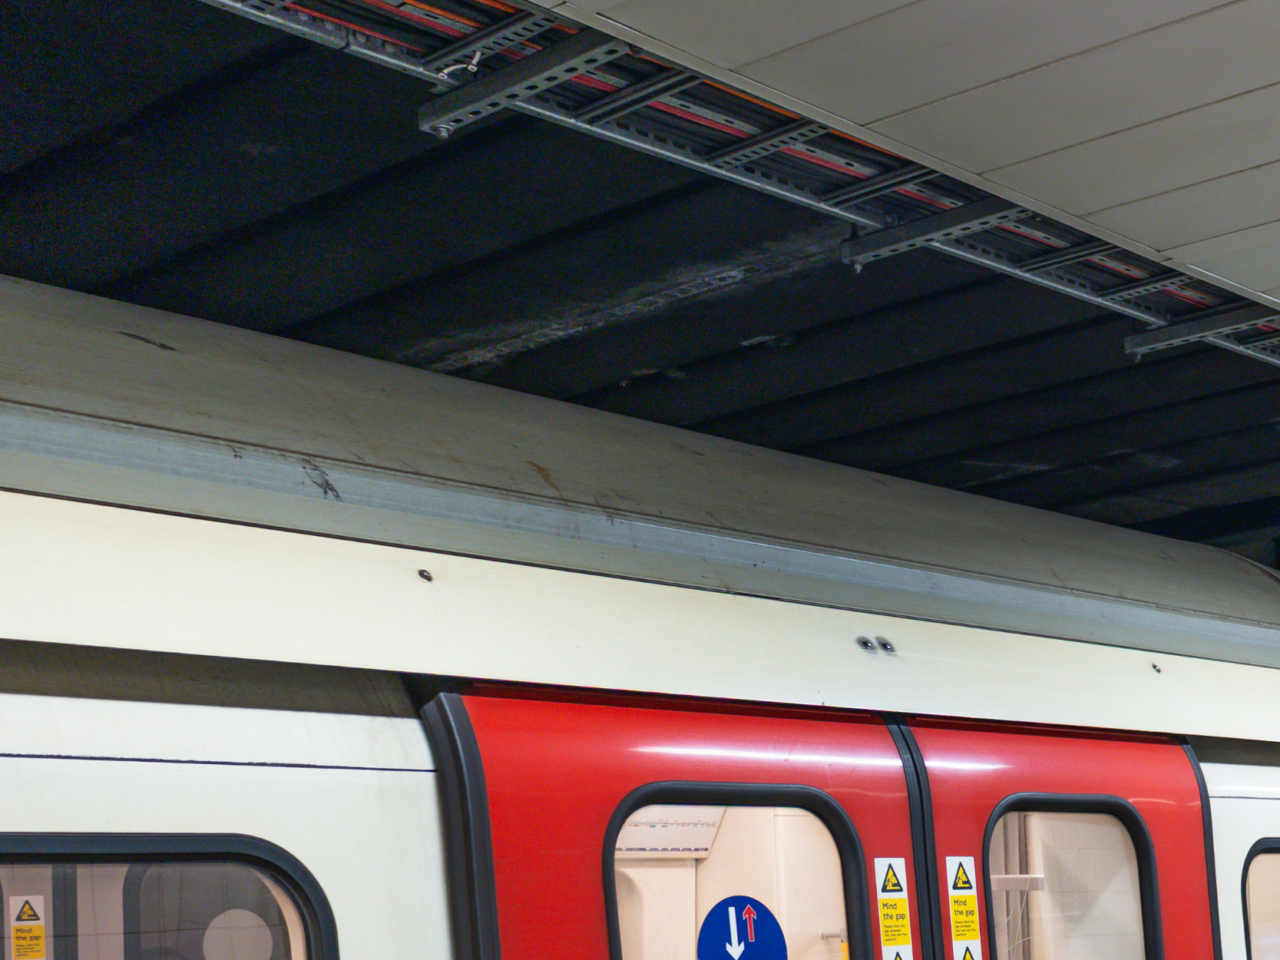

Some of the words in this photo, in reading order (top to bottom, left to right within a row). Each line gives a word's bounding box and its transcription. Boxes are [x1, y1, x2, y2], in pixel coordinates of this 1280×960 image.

[882, 902, 897, 910] Mind
[953, 899, 967, 907] Mind
[883, 912, 894, 920] the
[895, 913, 906, 921] gap
[954, 909, 964, 917] the
[965, 909, 975, 917] gap
